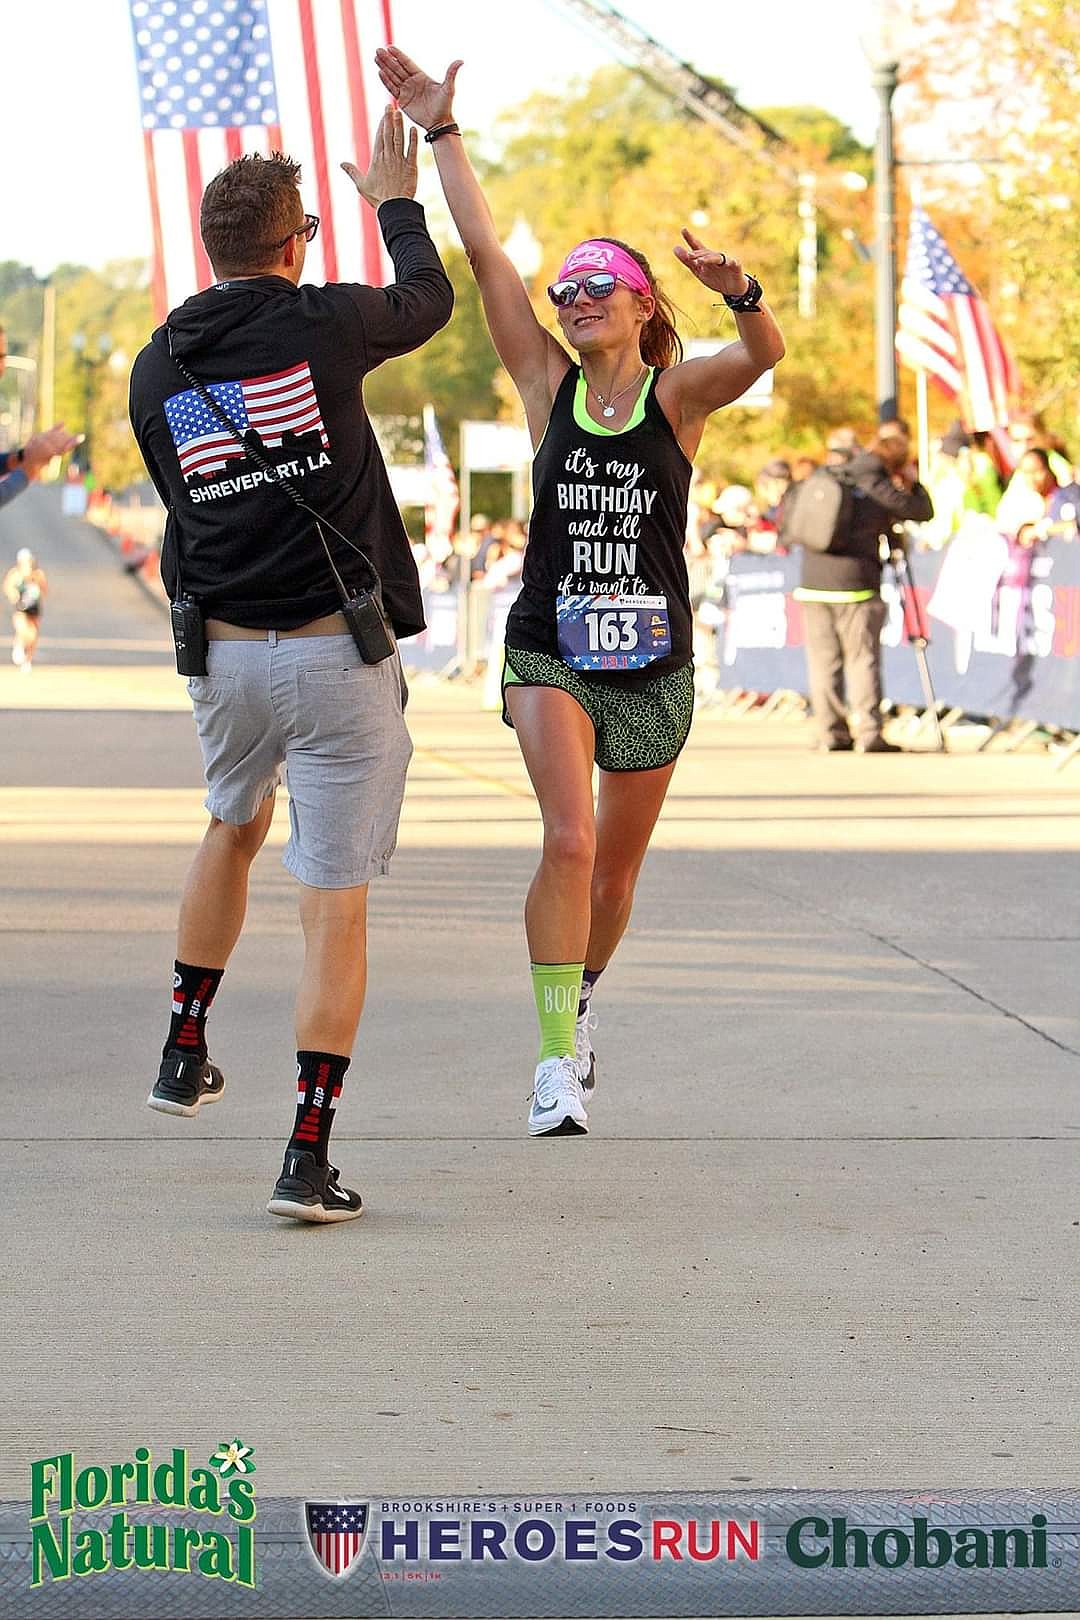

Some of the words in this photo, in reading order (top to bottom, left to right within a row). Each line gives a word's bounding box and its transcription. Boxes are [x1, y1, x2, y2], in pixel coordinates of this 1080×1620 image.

[307, 451, 332, 472] LA
[565, 447, 599, 479] it's
[605, 459, 646, 489] my
[557, 483, 658, 515] BIRTHDAY
[568, 512, 608, 538] and
[573, 541, 637, 575] RUN
[557, 573, 574, 597] if
[577, 577, 586, 592] i
[589, 575, 629, 596] want
[631, 575, 649, 596] to
[584, 612, 638, 651] 163
[544, 985, 578, 1014] BOO
